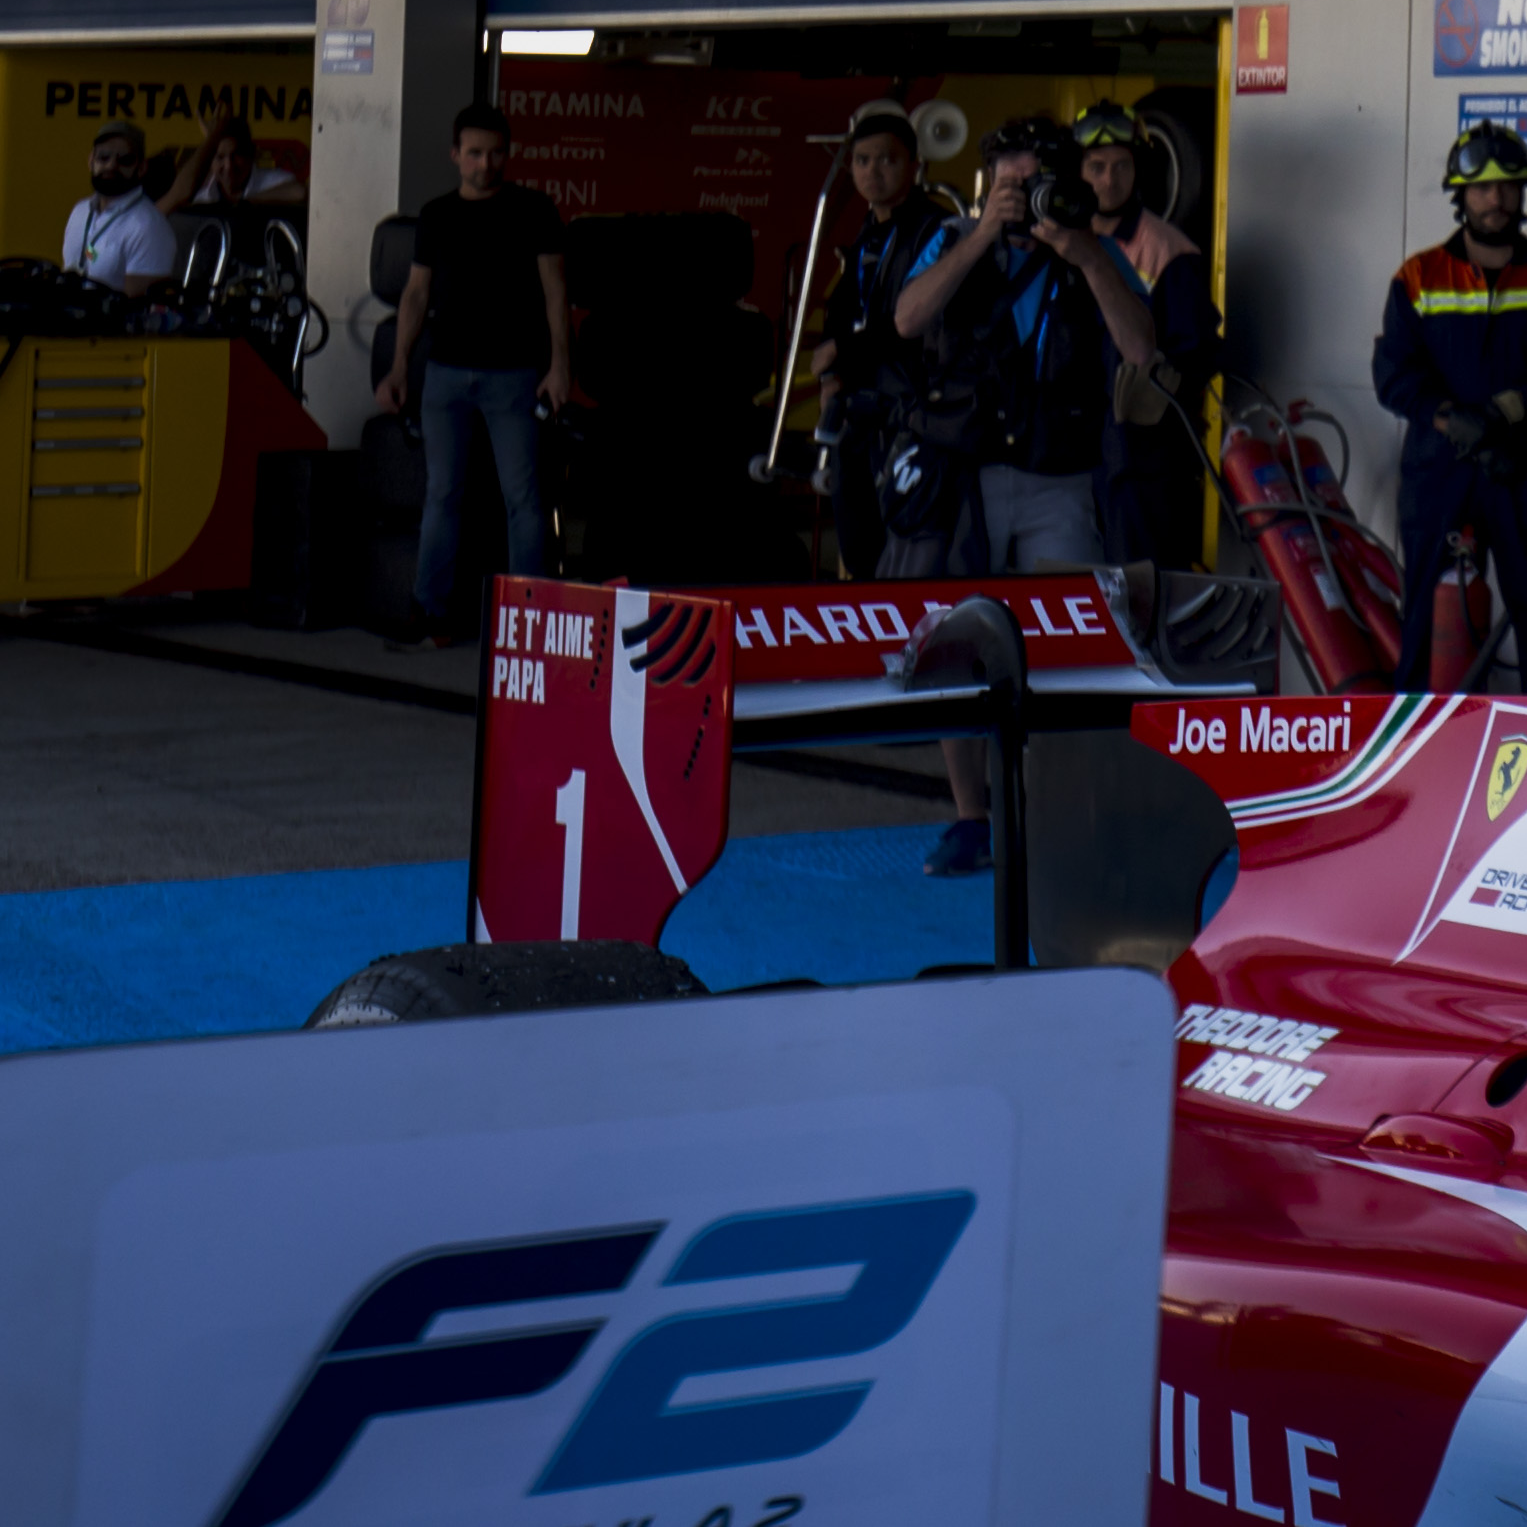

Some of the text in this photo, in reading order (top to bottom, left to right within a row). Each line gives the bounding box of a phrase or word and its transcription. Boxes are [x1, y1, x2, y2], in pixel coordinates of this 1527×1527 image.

[1238, 66, 1286, 86] EXTINTOR
[705, 95, 774, 121] KFC
[495, 604, 519, 651] JE
[492, 654, 546, 706] PAPA
[1169, 700, 1352, 754] Joe Macari
[554, 767, 587, 943] 1
[1174, 1002, 1344, 1063] THEODORE
[1180, 1049, 1328, 1112] RACING
